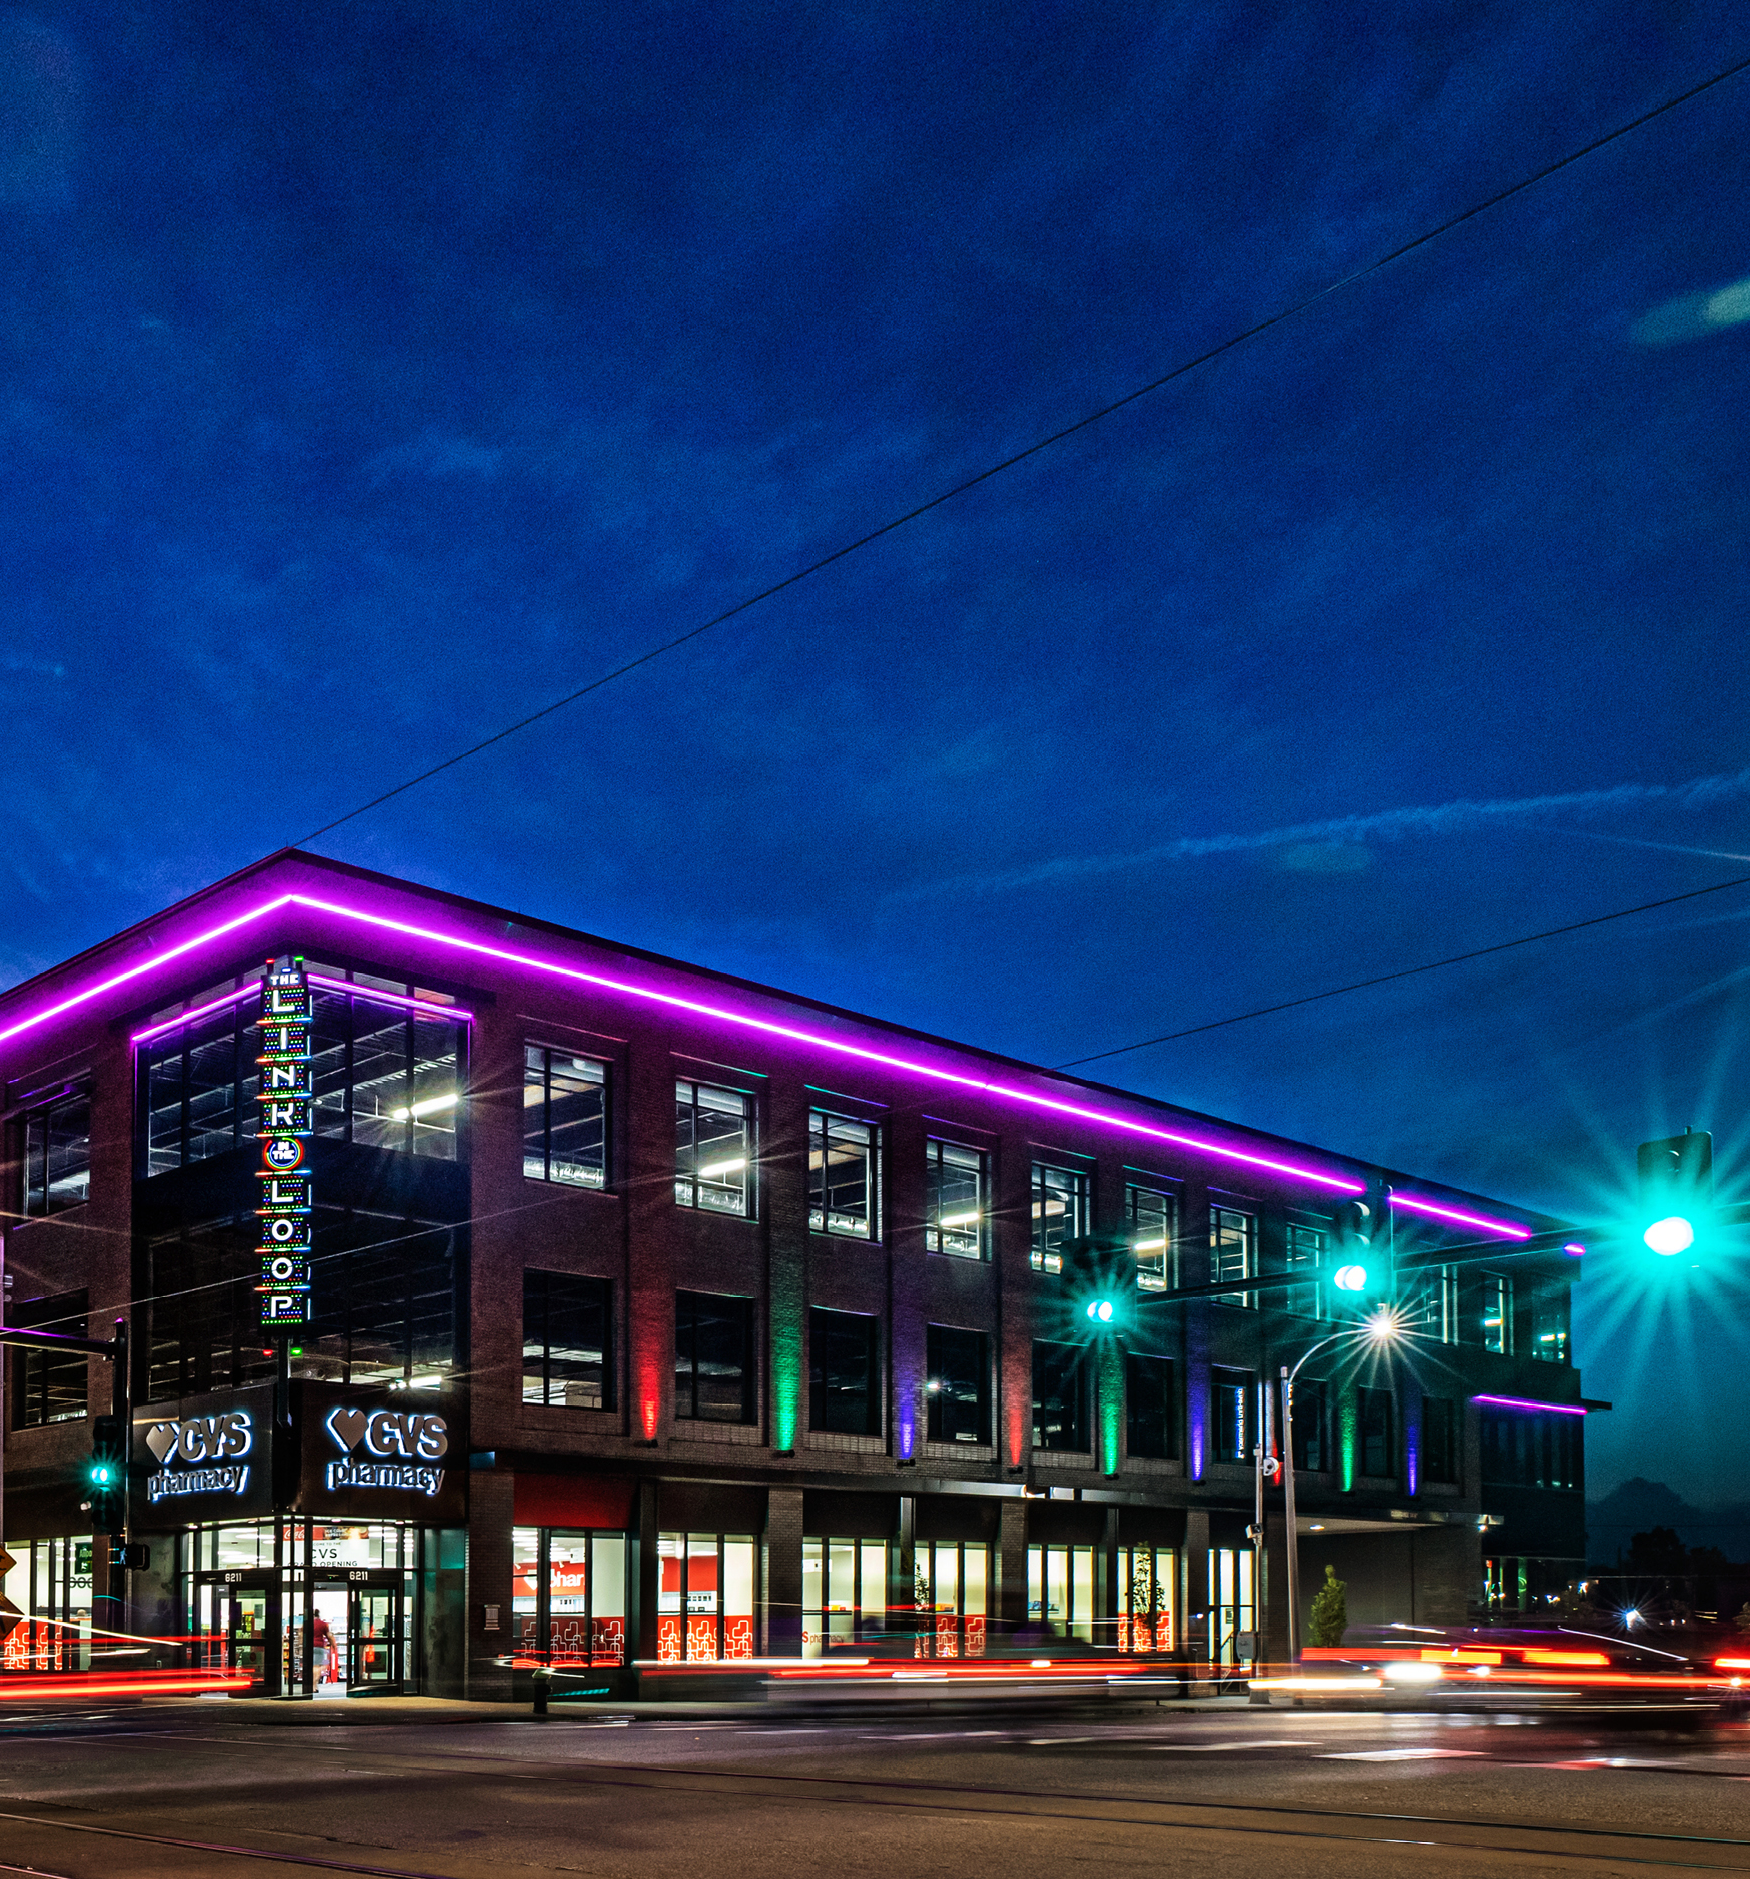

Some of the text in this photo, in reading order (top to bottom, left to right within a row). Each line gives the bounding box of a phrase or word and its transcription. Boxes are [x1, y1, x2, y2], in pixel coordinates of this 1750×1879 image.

[270, 974, 299, 986] THE
[272, 1150, 296, 1160] THE
[277, 1141, 290, 1151] IN
[271, 1180, 294, 1318] LOOP
[178, 1413, 251, 1461] CVS
[365, 1411, 448, 1458] CVS
[147, 1465, 249, 1502] pharmacy
[326, 1457, 446, 1495] pharmacy
[225, 1572, 242, 1583] 6211
[349, 1571, 368, 1581] 6211
